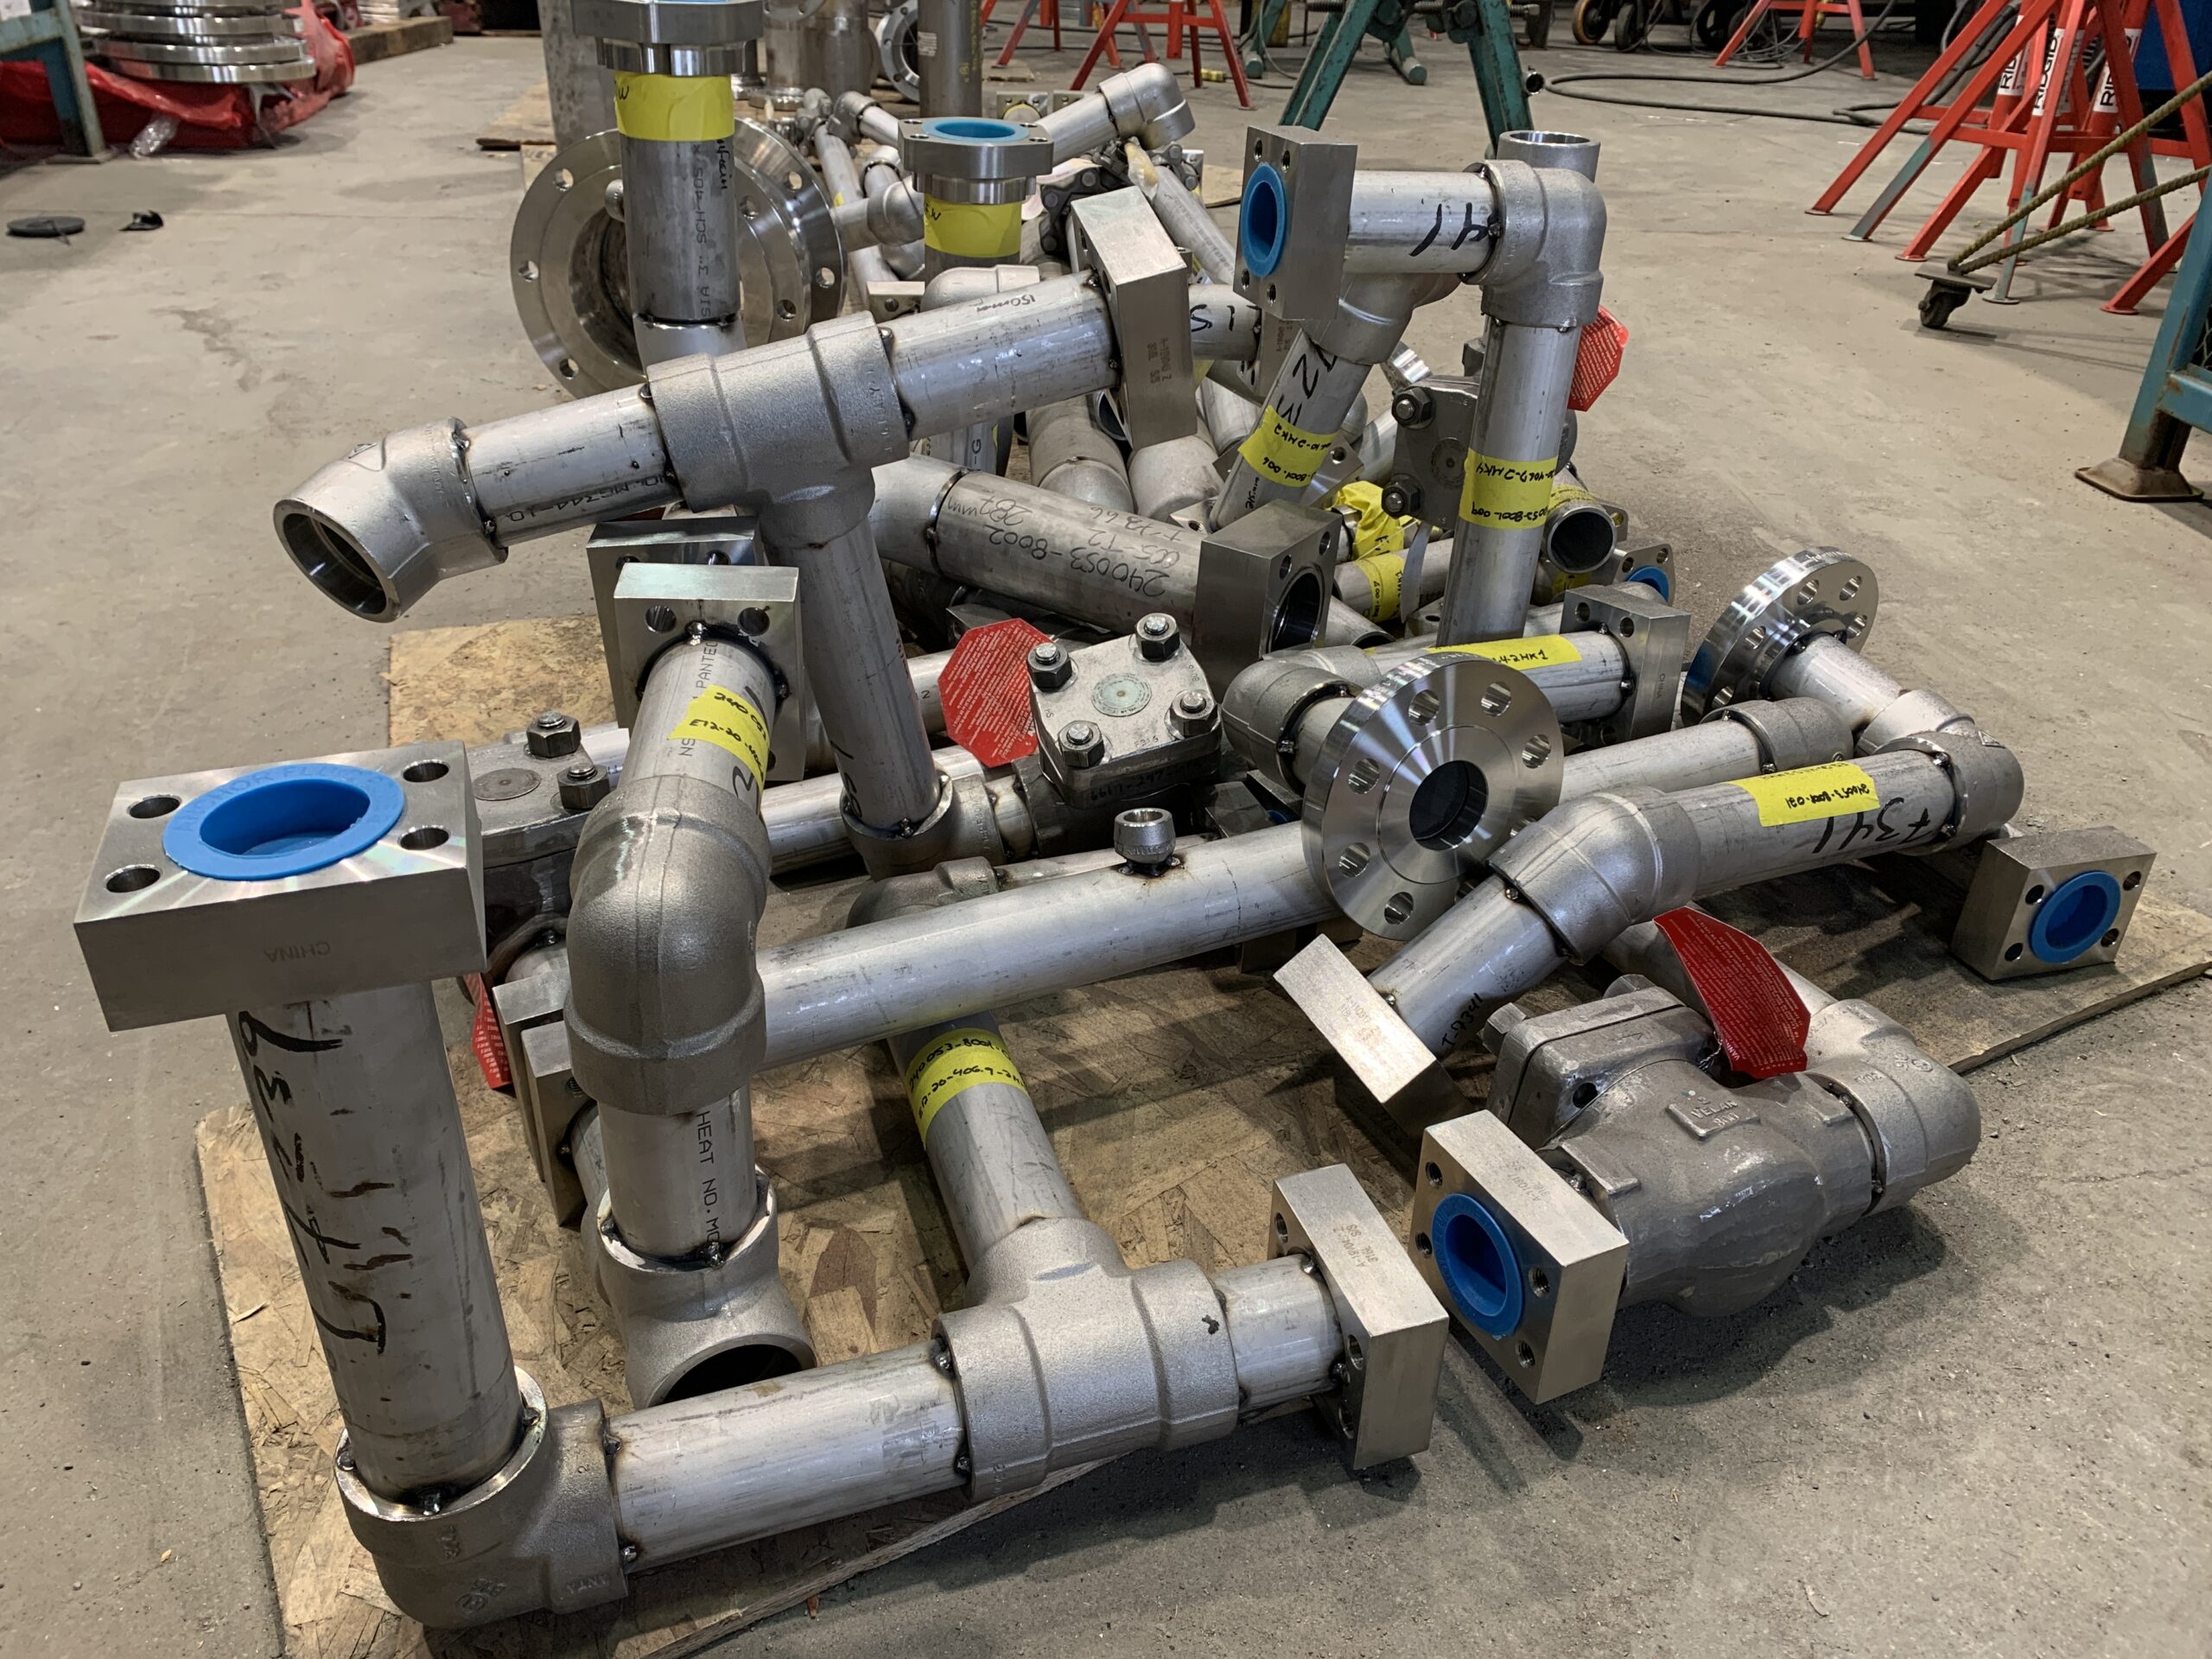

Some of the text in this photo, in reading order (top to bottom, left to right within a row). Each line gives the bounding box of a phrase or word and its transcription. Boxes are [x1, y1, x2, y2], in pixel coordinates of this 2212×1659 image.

[264, 940, 331, 963] CHINA
[1690, 1097, 1739, 1120] VELAN
[697, 1110, 715, 1165] HEAT
